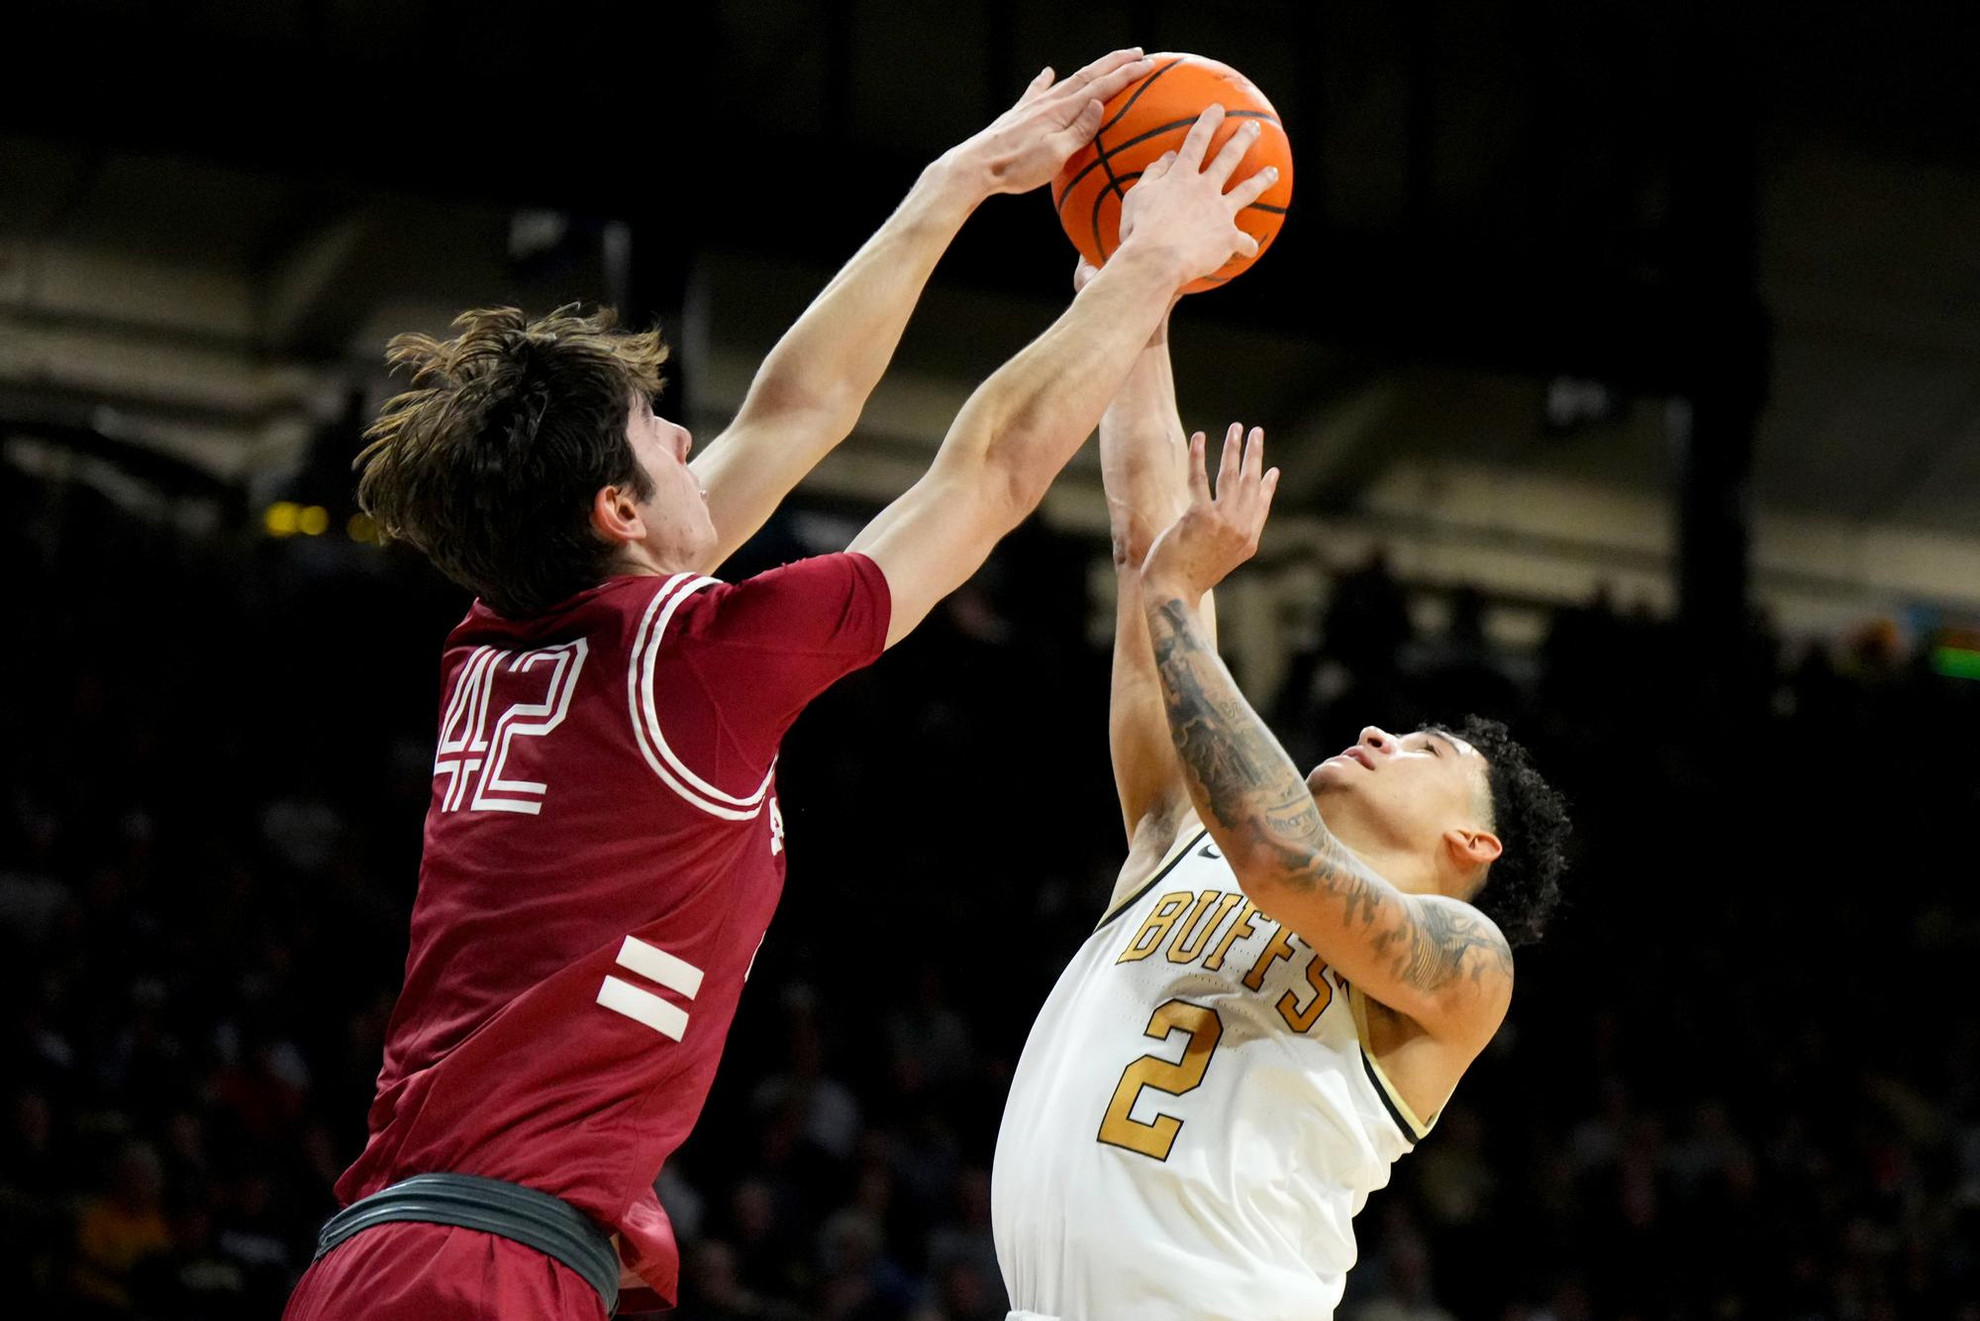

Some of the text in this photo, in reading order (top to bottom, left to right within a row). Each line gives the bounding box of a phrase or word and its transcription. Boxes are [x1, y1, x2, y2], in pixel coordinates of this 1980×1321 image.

[434, 637, 589, 815] 42
[1115, 889, 1346, 1034] BUFFS
[1096, 998, 1224, 1162] 2
